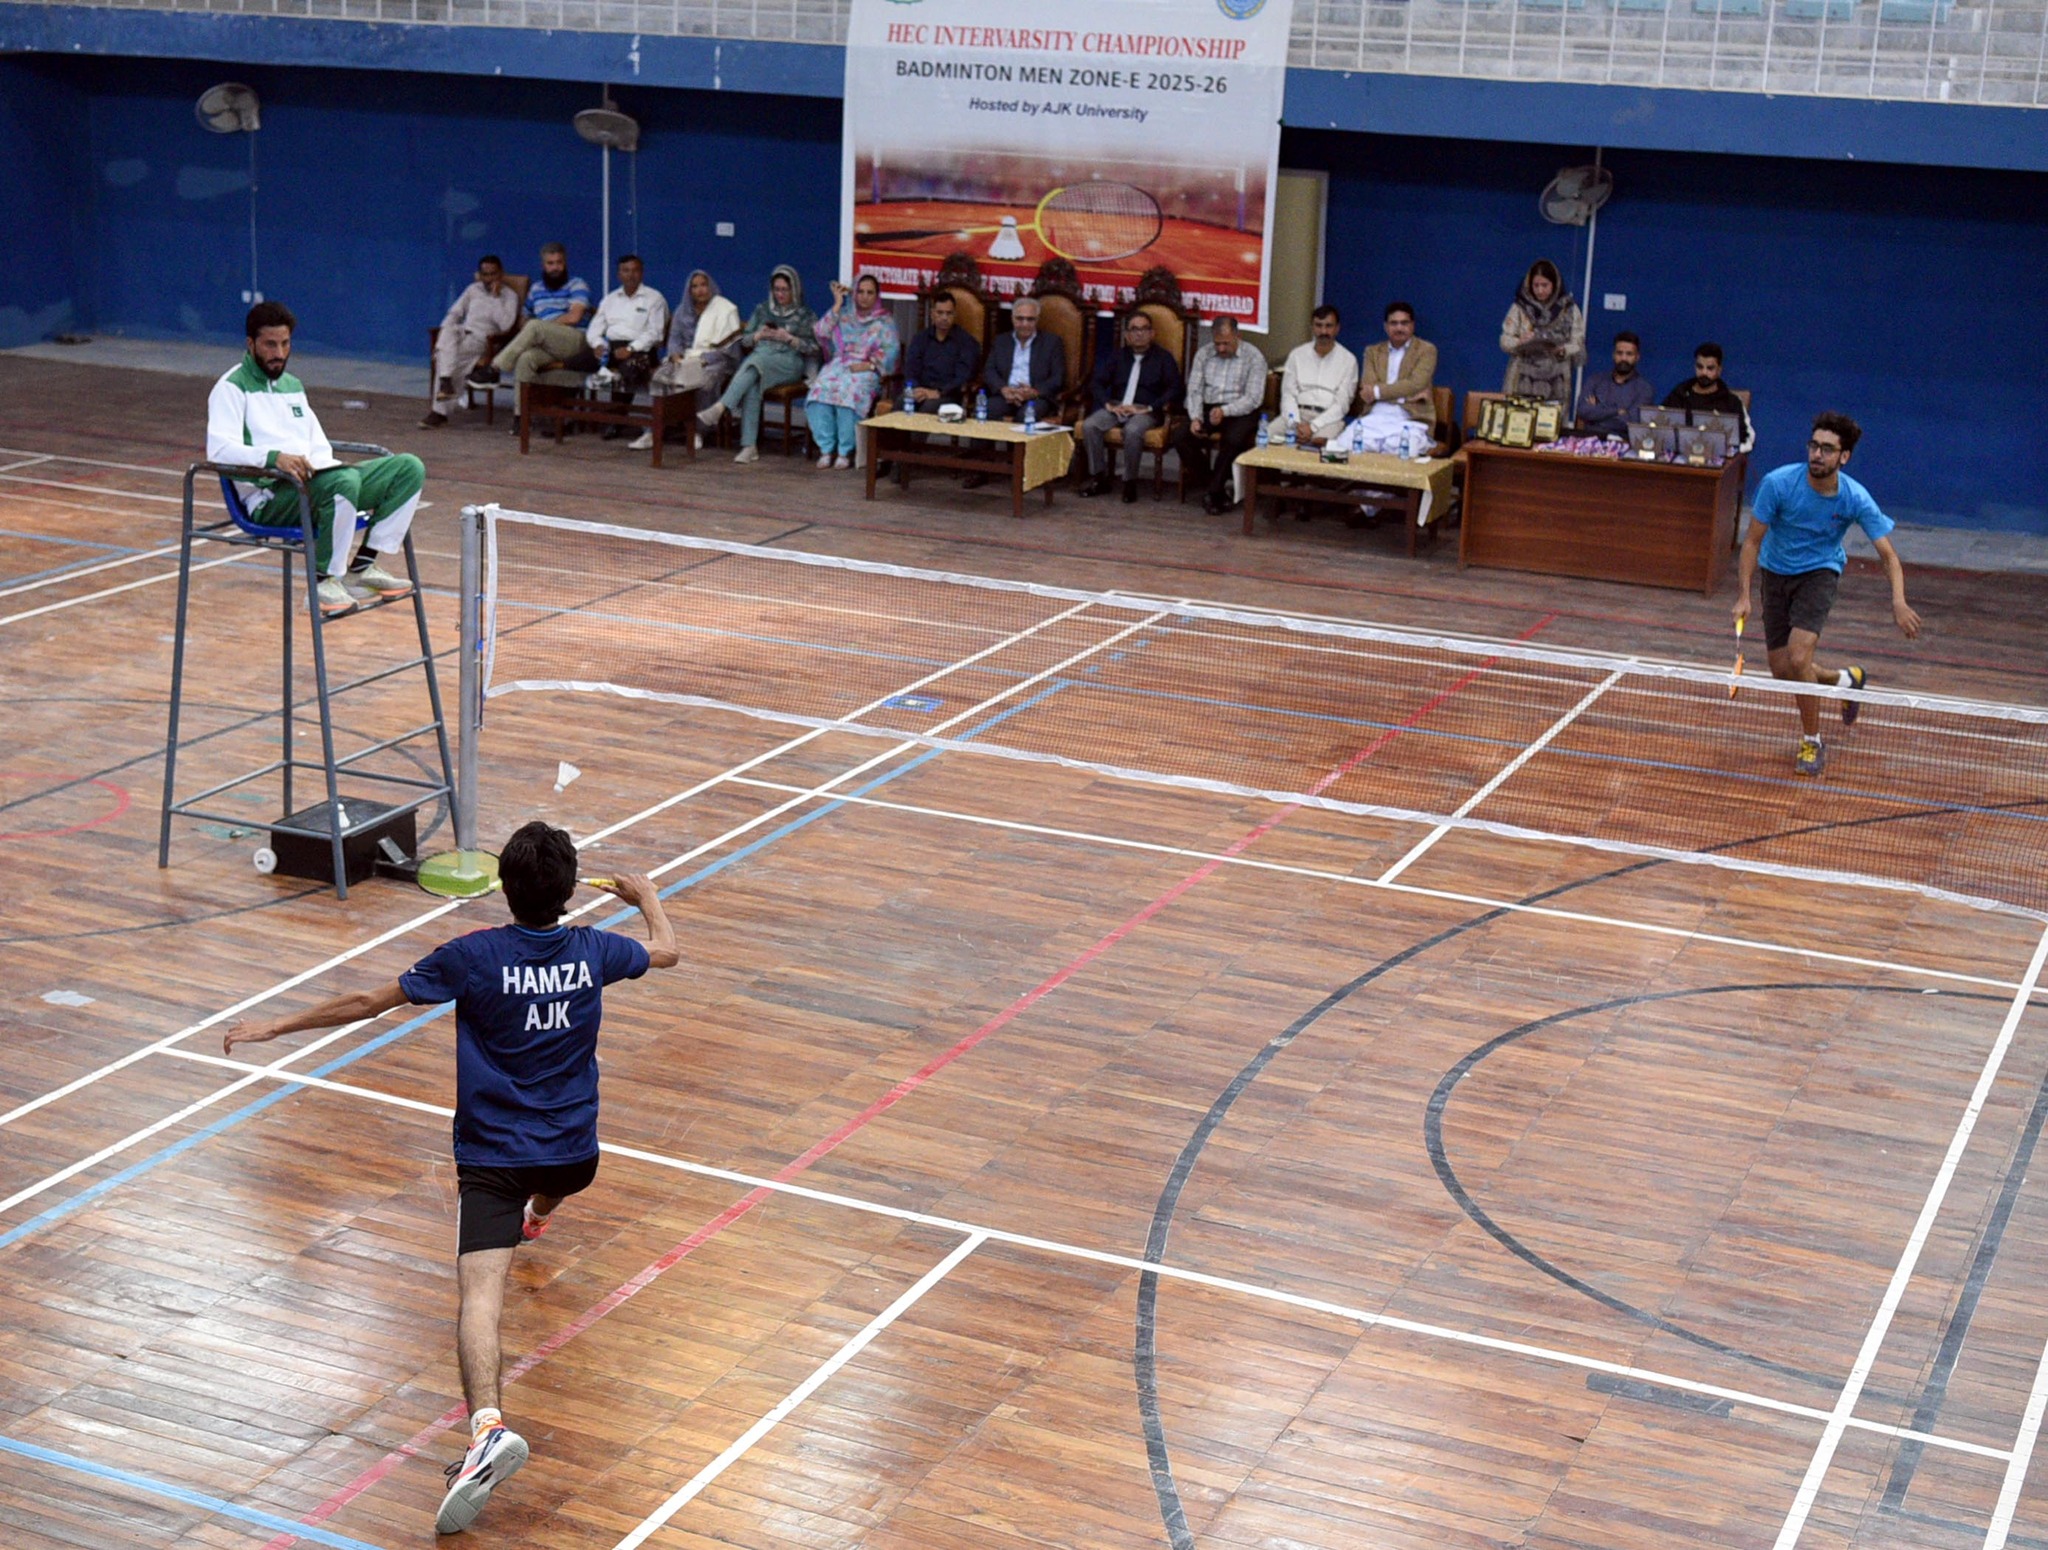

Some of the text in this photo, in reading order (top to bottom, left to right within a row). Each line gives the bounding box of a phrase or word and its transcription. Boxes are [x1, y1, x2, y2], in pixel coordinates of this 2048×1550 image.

[887, 23, 1246, 60] HEC INTERVARSITY CHAMPIONSHIP
[896, 60, 1227, 94] BADMINTON MEN ZONE-E 2025-26
[969, 98, 1149, 123] Hosted by AJK University
[502, 960, 593, 994] HAMZA
[524, 1000, 571, 1031] AJK
